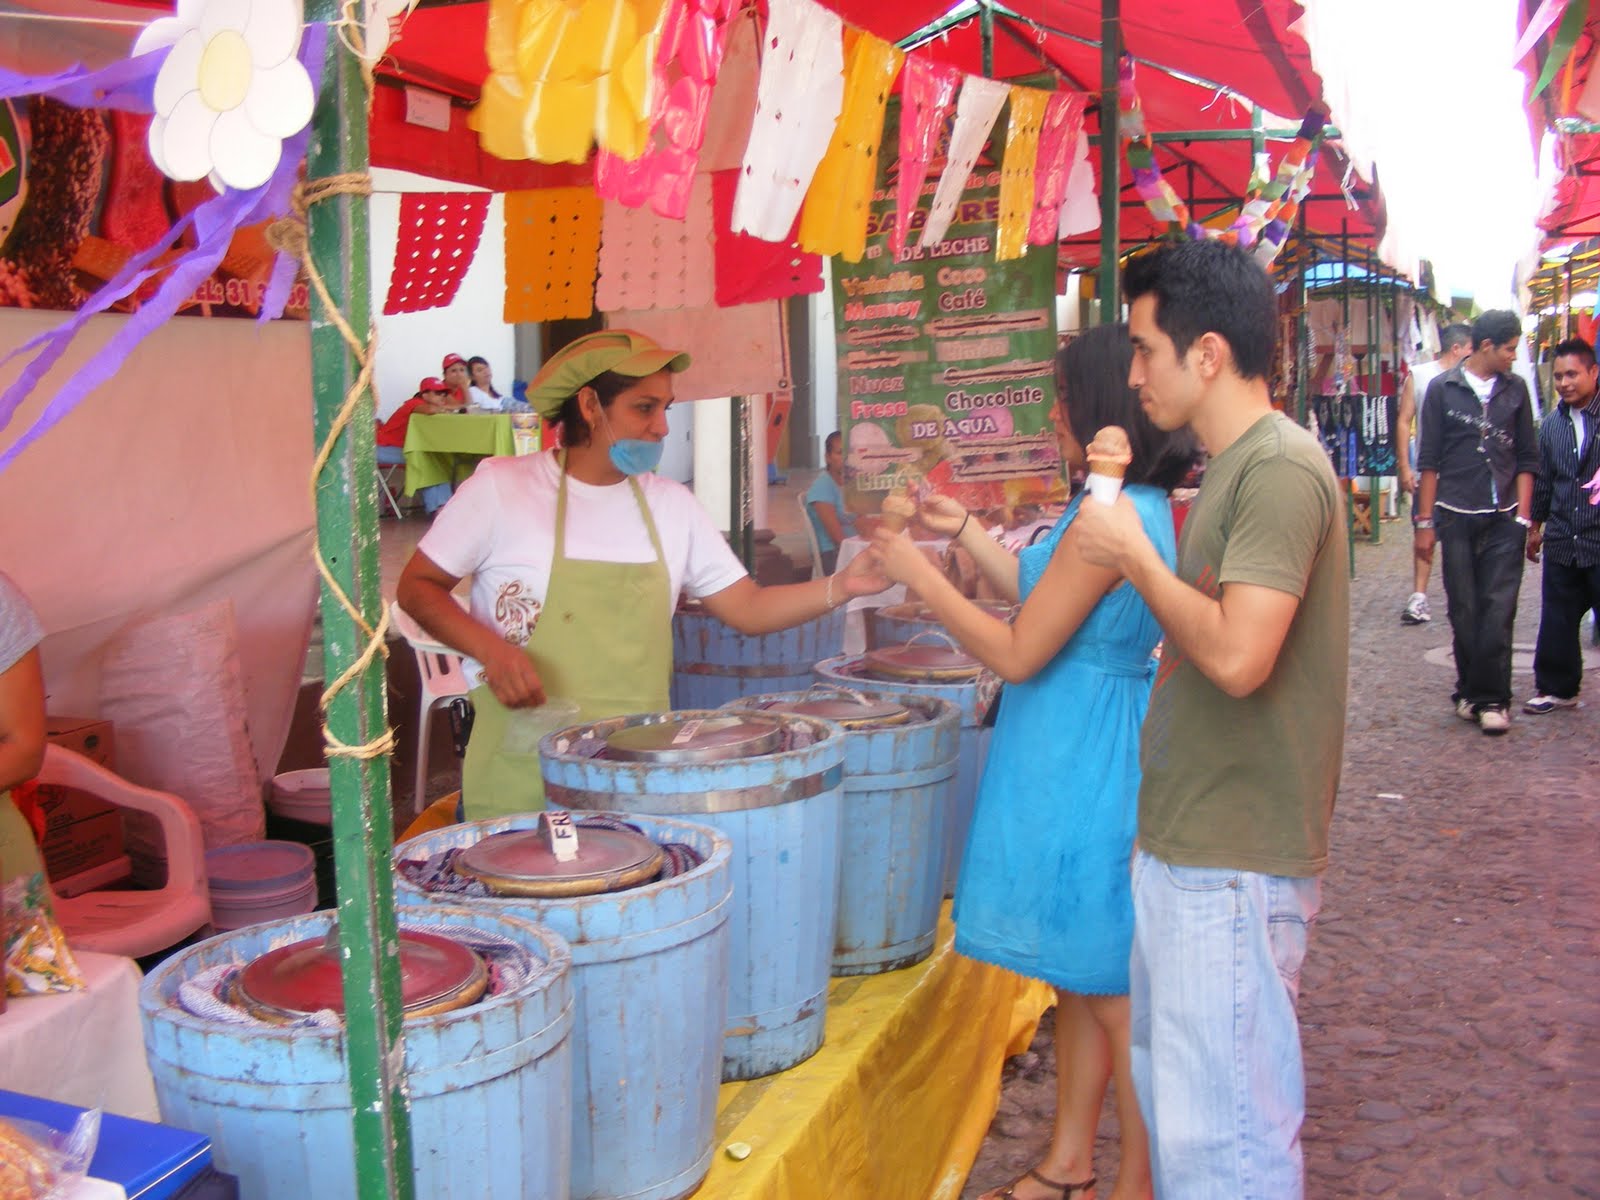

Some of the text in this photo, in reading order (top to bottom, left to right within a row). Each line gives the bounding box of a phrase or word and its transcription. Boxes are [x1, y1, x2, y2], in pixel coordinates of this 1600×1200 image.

[900, 247, 924, 262] DE
[929, 237, 991, 258] LECHE
[937, 266, 987, 287] Coco
[226, 278, 252, 306] 31
[939, 288, 986, 312] Café
[845, 300, 921, 321] Mamey
[849, 375, 905, 395] Nuez
[945, 385, 1044, 411] Chocolate
[851, 400, 909, 420] Fresa
[912, 416, 998, 439] DE AGUA
